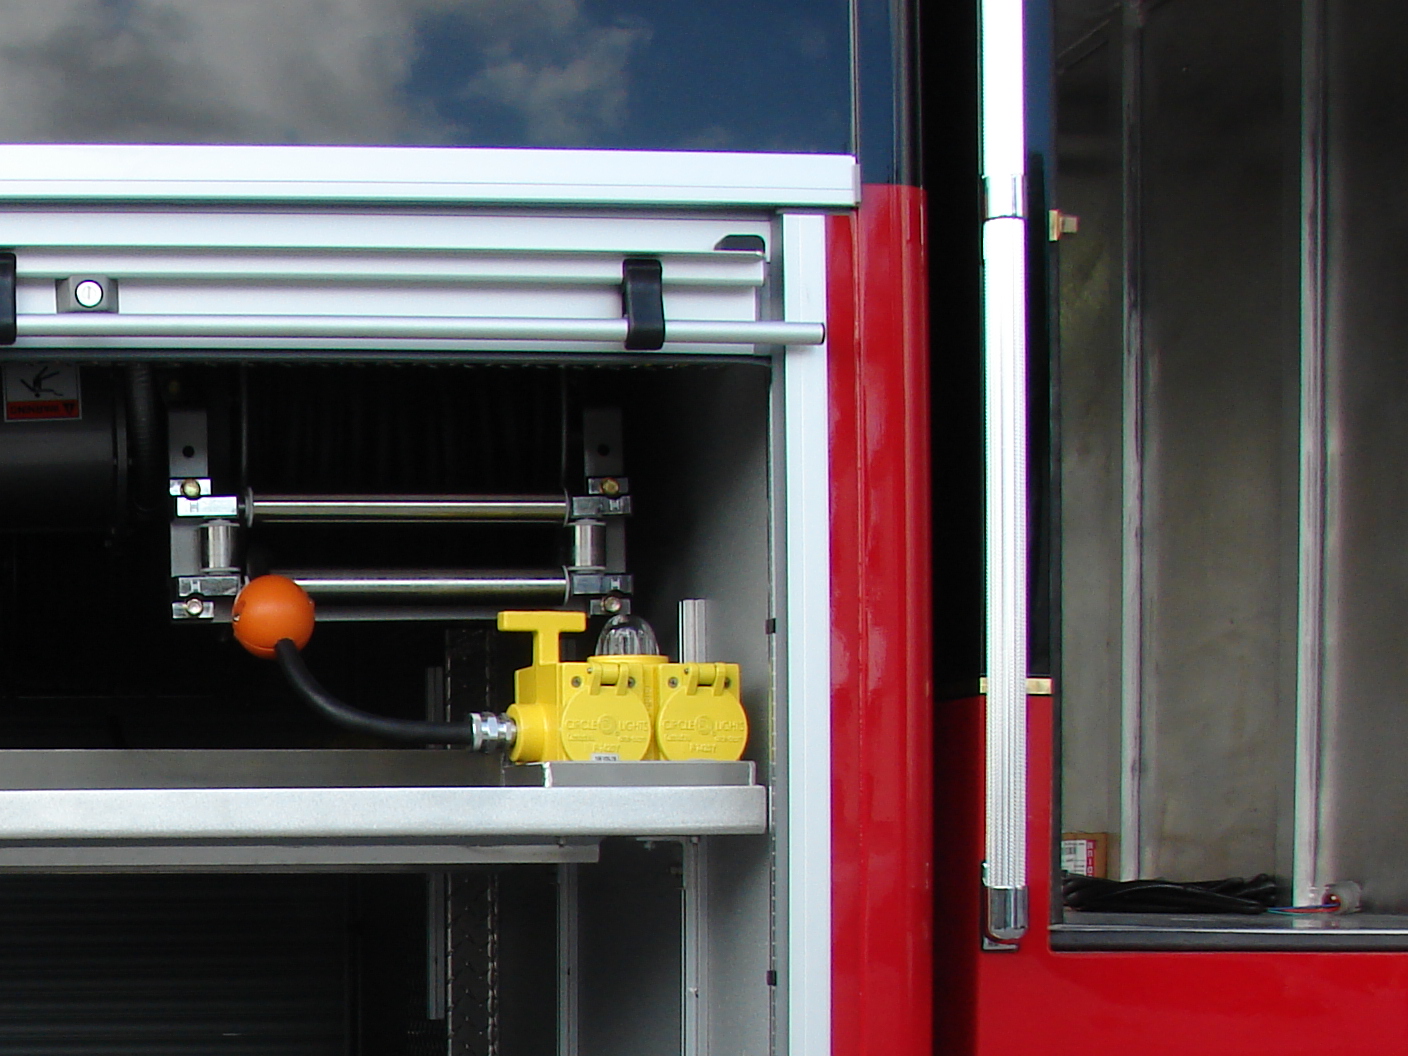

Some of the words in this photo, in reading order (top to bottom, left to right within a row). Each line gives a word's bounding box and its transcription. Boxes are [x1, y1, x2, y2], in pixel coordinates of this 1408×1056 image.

[566, 719, 598, 731] CIRCLE
[619, 720, 650, 732] LIGHTS
[663, 719, 696, 731] CIRCLE
[715, 720, 745, 732] LIGHTS
